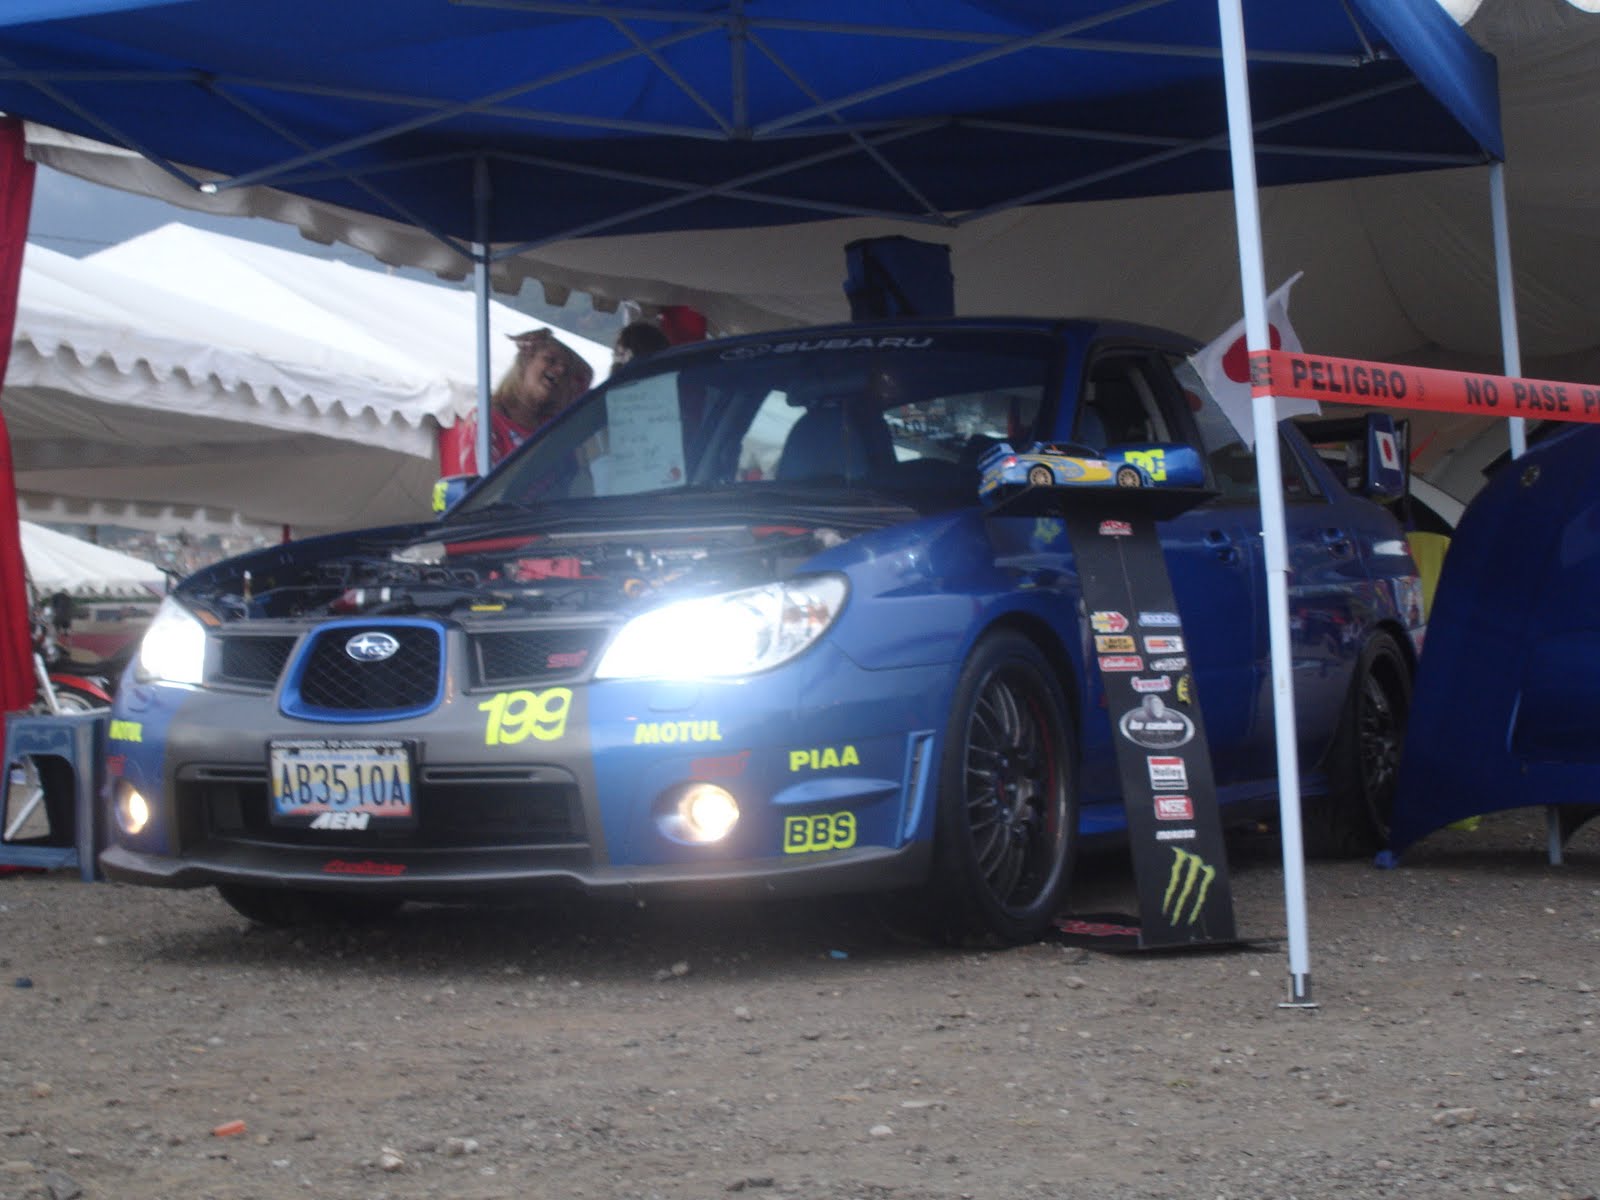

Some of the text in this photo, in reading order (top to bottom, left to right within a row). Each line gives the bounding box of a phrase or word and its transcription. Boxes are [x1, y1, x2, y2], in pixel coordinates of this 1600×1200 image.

[774, 337, 933, 353] SUBARU
[1291, 359, 1408, 400] PELIGRO
[1464, 377, 1499, 407] NO
[1512, 381, 1571, 412] PASE
[1582, 389, 1600, 414] P
[478, 687, 573, 746] 199
[634, 720, 722, 745] MOTUL
[789, 745, 860, 772] PIAA
[281, 764, 406, 806] AB3510A
[309, 811, 371, 830] AEM
[784, 811, 857, 854] BBS
